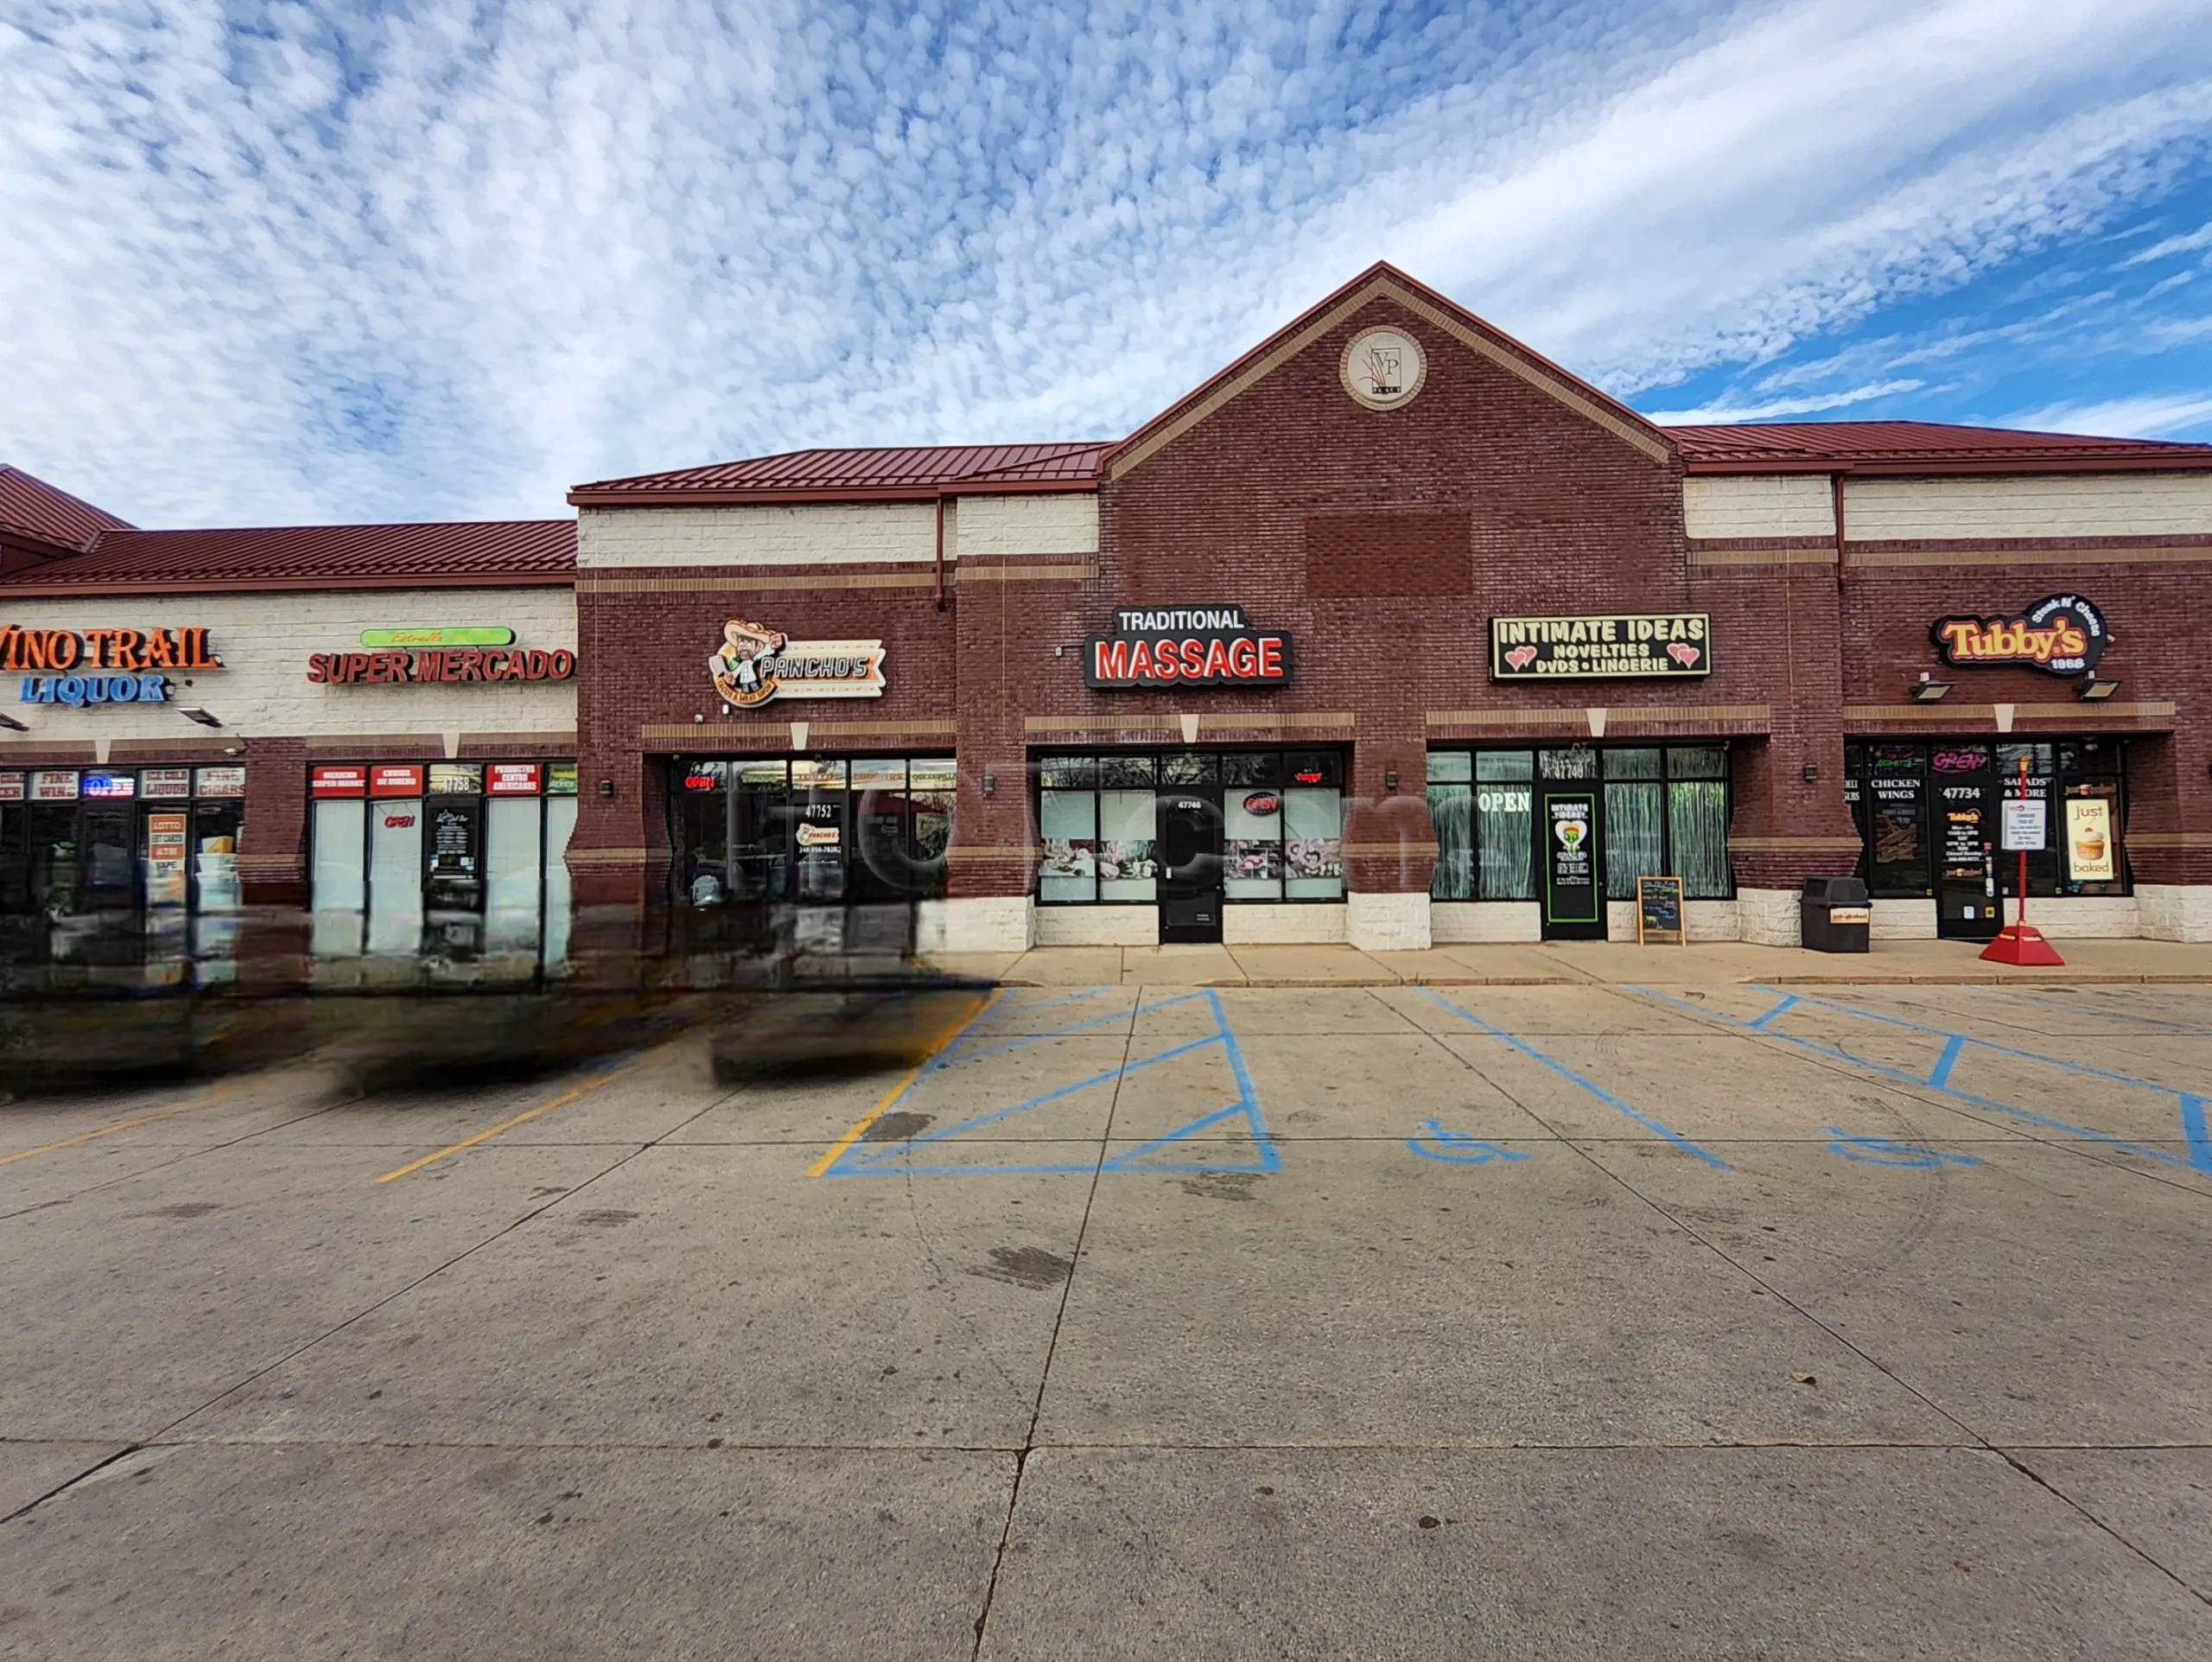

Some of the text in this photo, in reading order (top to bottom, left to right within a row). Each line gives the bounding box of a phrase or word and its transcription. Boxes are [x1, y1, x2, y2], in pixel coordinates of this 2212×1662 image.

[1119, 610, 1244, 631] TRADITIONAL
[2032, 599, 2061, 623] Steak
[2075, 602, 2101, 637] Cheese
[1500, 619, 1704, 644] INTIMATE IDEAS
[1941, 617, 2086, 661] Tubby's
[83, 627, 219, 671] TRAIL
[1553, 643, 1650, 659] NOVELTIES
[1095, 638, 1284, 680] MASSAGE
[1535, 658, 1669, 673] DVDS LINGERIE
[307, 649, 573, 685] SUPER MERCADO
[760, 657, 868, 678] PANCHO'S
[17, 674, 168, 707] LIQUOR
[1932, 752, 1986, 769] OPEN
[41, 773, 74, 784] FINE
[146, 771, 188, 780] ICE COLD
[685, 776, 715, 788] OPEN
[145, 784, 188, 795] LIQUOR
[199, 785, 245, 795] CIGARS
[442, 777, 470, 792] 47758
[1871, 779, 1921, 788] CHICKEN
[39, 786, 76, 798] WINE
[1878, 790, 1916, 799] WINGS
[1942, 787, 1980, 799] 47734
[1178, 801, 1202, 810] 47746
[1245, 797, 1278, 811] OPEN
[1478, 793, 1530, 812] OPEN
[804, 804, 831, 818] 47752
[2074, 806, 2103, 820] just
[2074, 862, 2109, 873] baked
